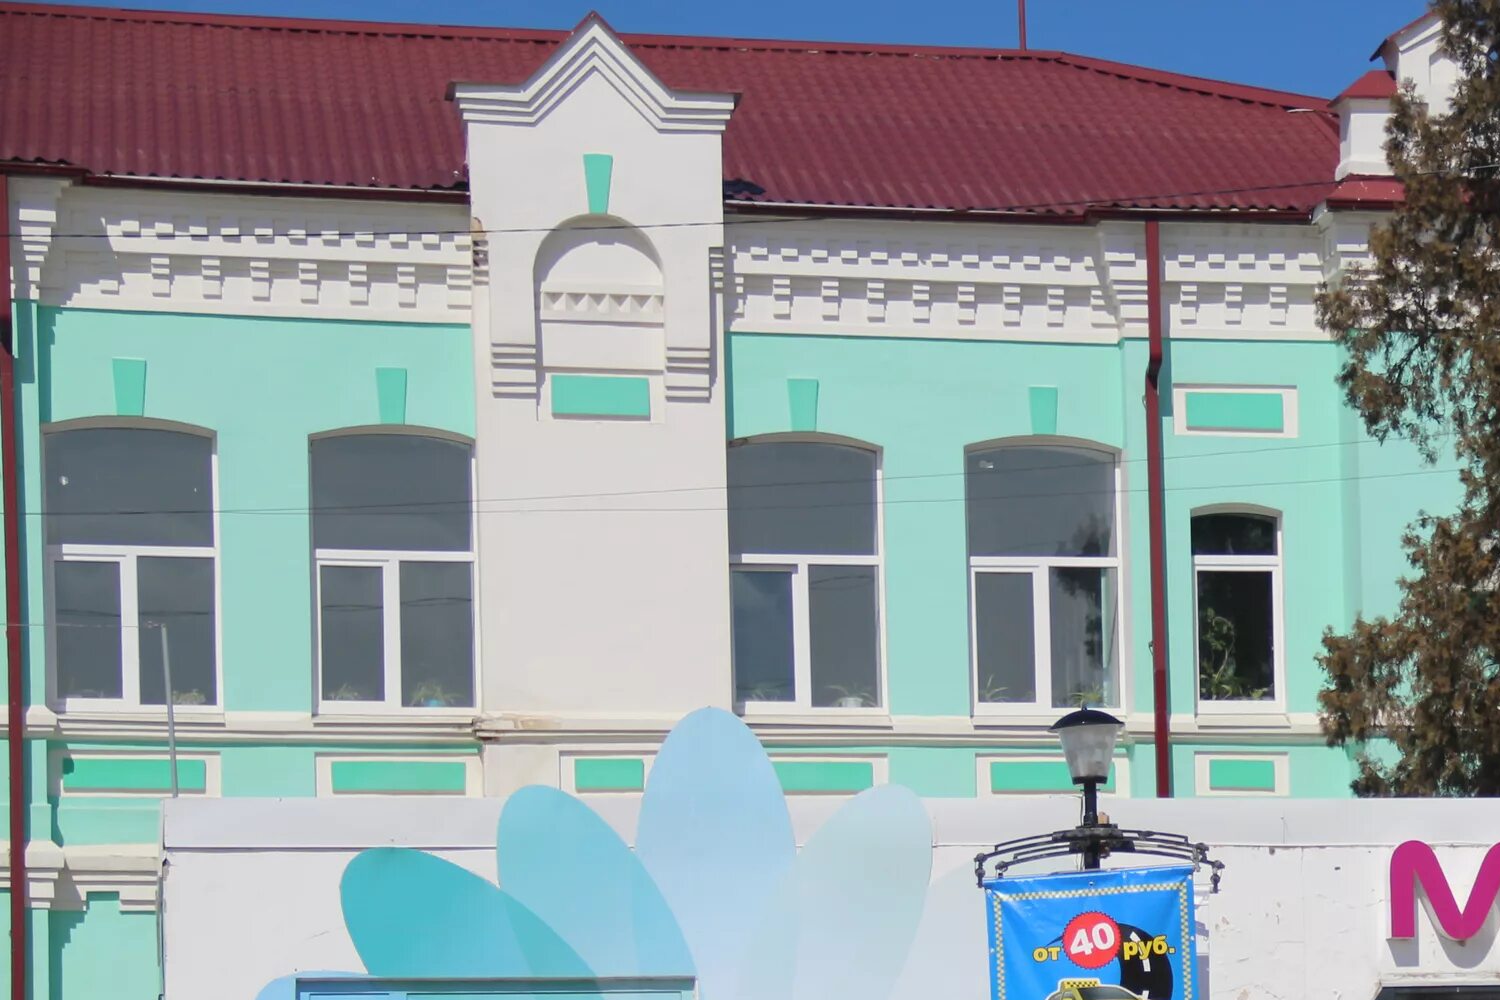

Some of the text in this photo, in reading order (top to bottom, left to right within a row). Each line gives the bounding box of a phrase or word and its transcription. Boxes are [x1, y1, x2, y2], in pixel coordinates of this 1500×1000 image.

[1033, 922, 1175, 962] от 40 руб.
